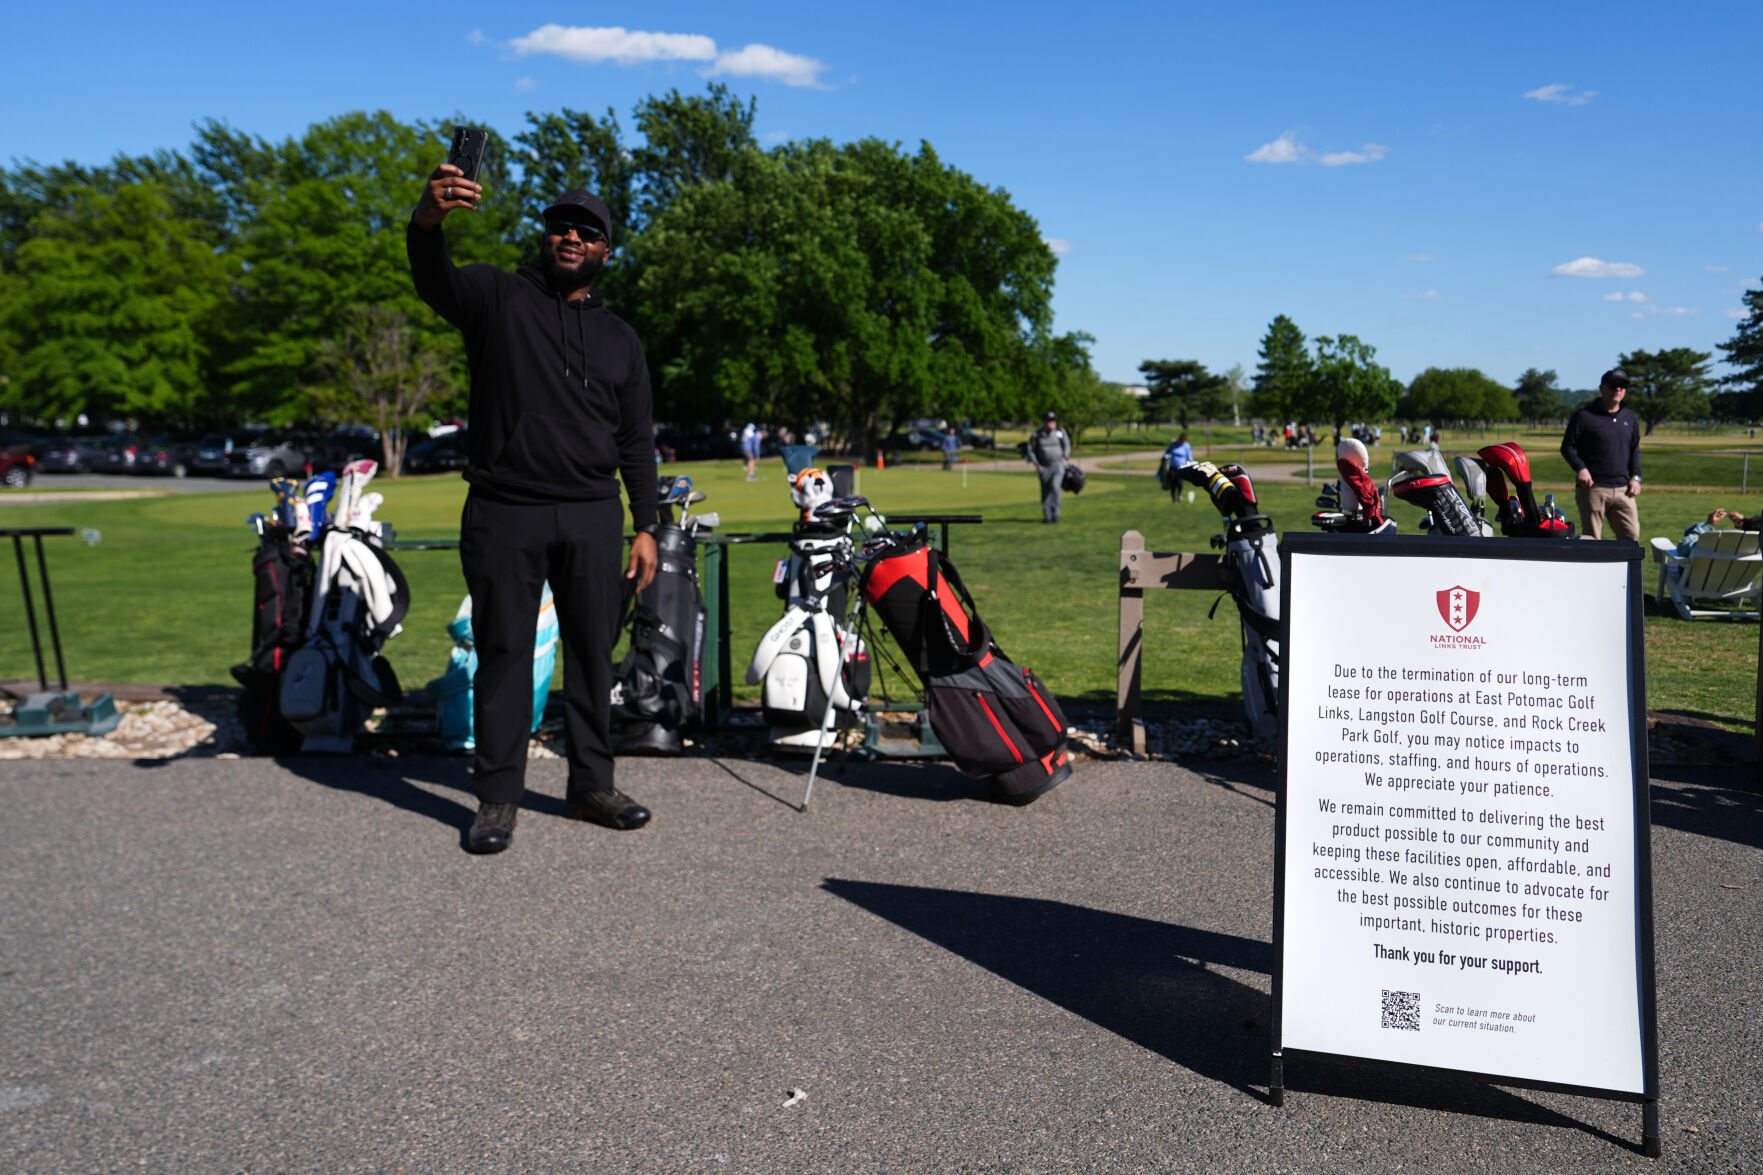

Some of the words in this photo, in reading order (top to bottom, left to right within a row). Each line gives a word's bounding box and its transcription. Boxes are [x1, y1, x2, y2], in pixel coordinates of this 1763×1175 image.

[1446, 488, 1480, 537] STEAL
[1430, 635, 1487, 644] NATIONAL
[1335, 664, 1357, 678] Due
[1362, 666, 1373, 679] to
[1378, 666, 1397, 680] the
[1402, 668, 1474, 683] termination
[1480, 670, 1492, 683] of
[1497, 674, 1518, 684] our
[1523, 671, 1587, 690] long-term
[1328, 685, 1360, 700] lease
[1365, 686, 1383, 700] for
[1388, 689, 1453, 705] operations
[1459, 691, 1471, 704] at
[1476, 691, 1503, 706] East
[1508, 692, 1563, 709] Potomac
[1569, 695, 1595, 710] Golf
[1319, 705, 1353, 721] Links,
[1359, 707, 1415, 726] Langston
[1421, 710, 1446, 725] Golf
[1451, 711, 1498, 728] Course,
[1504, 715, 1526, 729] and
[1532, 715, 1563, 731] Rock
[1569, 717, 1606, 733] Creek
[1342, 728, 1369, 743] Park
[1374, 729, 1402, 745] Golf,
[1407, 735, 1429, 748] you
[1435, 736, 1461, 751] may
[1466, 735, 1505, 750] notice
[1510, 736, 1562, 755] impacts
[1567, 740, 1579, 754] to
[1316, 750, 1384, 766] operations,
[1389, 753, 1441, 772] staffing,
[1447, 756, 1470, 770] and
[1475, 756, 1511, 772] hours
[1517, 759, 1529, 773] of
[1535, 762, 1608, 778] operations.
[1365, 772, 1383, 787] We
[1388, 776, 1455, 792] appreciate
[1460, 781, 1489, 795] your
[1494, 781, 1554, 798] patience.
[1319, 798, 1337, 814] We
[1342, 802, 1384, 816] remain
[1389, 806, 1456, 821] committed
[1461, 809, 1474, 823] to
[1480, 809, 1544, 831] delivering
[1549, 813, 1570, 829] the
[1576, 815, 1605, 831] best
[1333, 823, 1380, 839] product
[1385, 827, 1438, 843] possible
[1443, 830, 1455, 844] to
[1461, 834, 1482, 845] our
[1487, 836, 1560, 855] community
[1565, 839, 1589, 853] and
[1313, 842, 1361, 863] keeping
[1366, 846, 1400, 862] these
[1405, 849, 1461, 867] facilities
[1466, 857, 1501, 872] open,
[1508, 857, 1580, 877] affordable,
[1587, 864, 1611, 878] and
[1314, 868, 1384, 883] accessible.
[1389, 870, 1408, 885] We
[1413, 872, 1439, 888] also
[1445, 877, 1501, 893] continue
[1506, 880, 1519, 894] to
[1524, 881, 1584, 899] advocate
[1590, 886, 1610, 901] for
[1337, 889, 1357, 904] the
[1362, 890, 1389, 906] best
[1394, 896, 1447, 911] possible
[1453, 900, 1517, 917] outcomes
[1522, 904, 1541, 919] for
[1546, 906, 1583, 923] these
[1360, 913, 1425, 933] important,
[1431, 918, 1480, 937] historic
[1486, 927, 1558, 944] properties.
[1373, 944, 1410, 961] Thank
[1413, 951, 1435, 966] you
[1439, 950, 1457, 966] for
[1460, 956, 1488, 971] your
[1491, 959, 1543, 976] support.
[1433, 1018, 1446, 1026] our
[1448, 1020, 1477, 1029] current
[1479, 1021, 1516, 1034] situation.
[1435, 1004, 1455, 1014] Scan
[1457, 1006, 1465, 1015] to
[1467, 1007, 1488, 1018] learn
[1490, 1012, 1511, 1020] more
[1513, 1012, 1536, 1023] about
